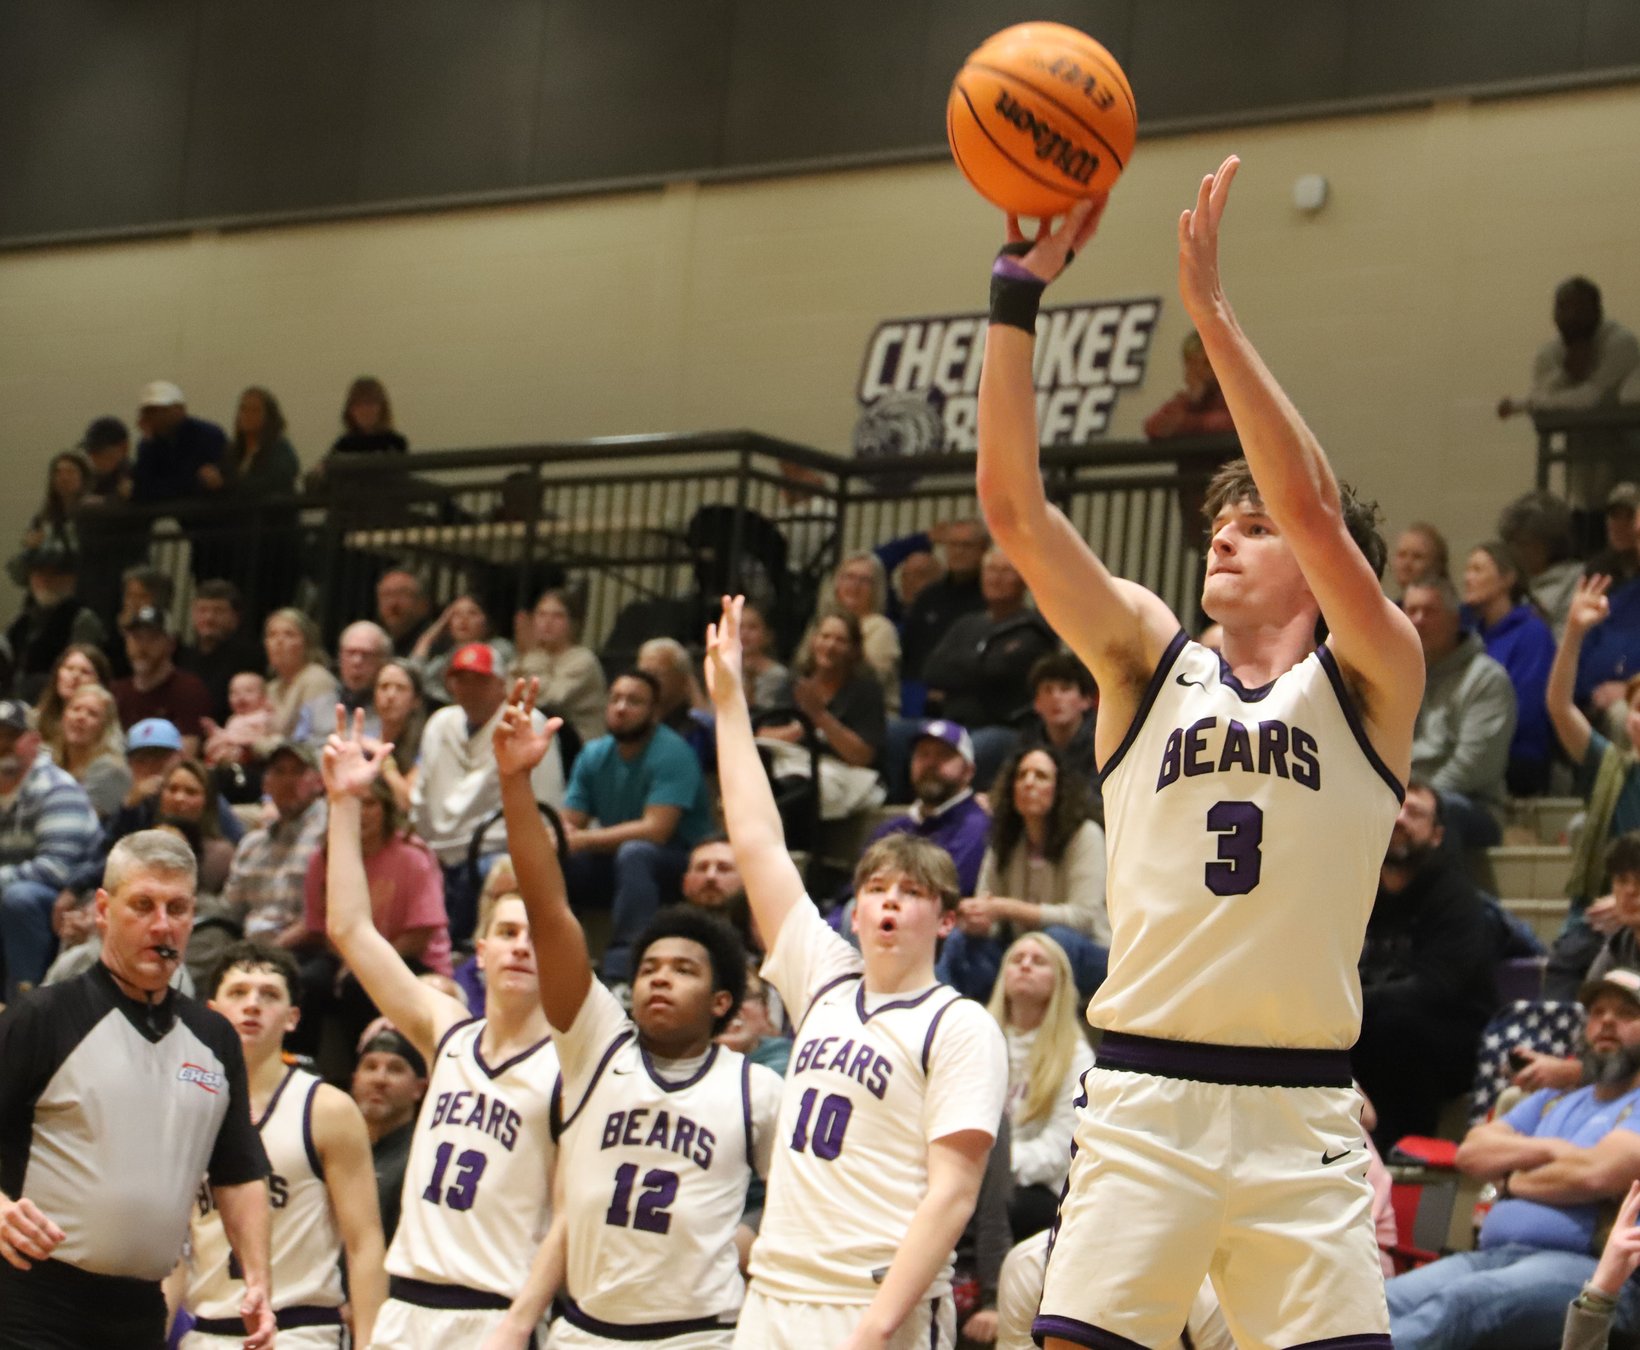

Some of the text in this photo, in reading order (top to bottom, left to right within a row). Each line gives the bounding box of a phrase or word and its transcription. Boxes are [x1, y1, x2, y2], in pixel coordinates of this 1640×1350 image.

[994, 89, 1099, 185] Wilson
[860, 301, 1160, 403] CHEKEE
[945, 386, 1115, 451] BFF
[1156, 716, 1321, 793] BEARS
[1204, 800, 1264, 896] 3
[794, 1036, 893, 1100] BEARS
[430, 1091, 522, 1152] BEARS
[601, 1108, 717, 1171] BEARS
[790, 1087, 853, 1161] 10
[422, 1141, 488, 1212] 13
[606, 1162, 680, 1235] 12
